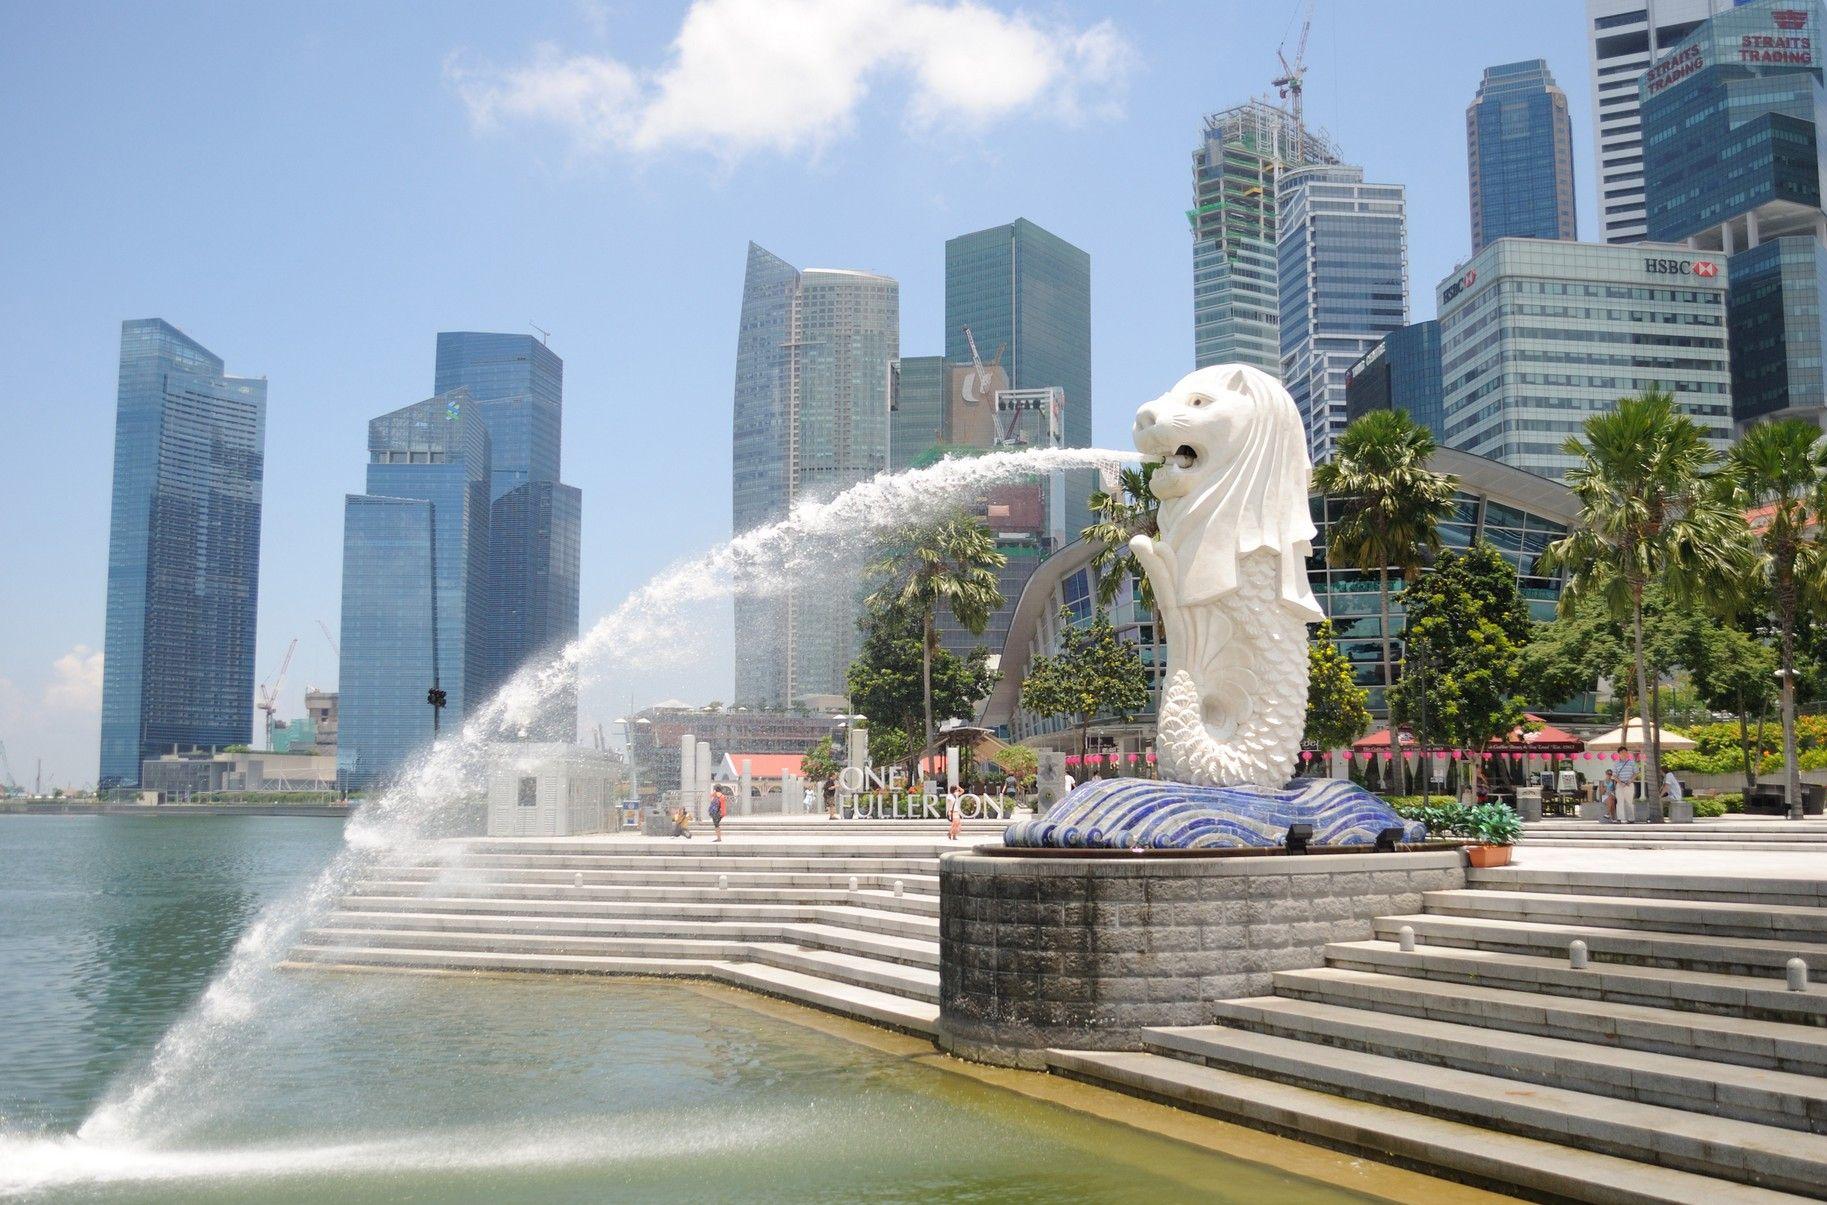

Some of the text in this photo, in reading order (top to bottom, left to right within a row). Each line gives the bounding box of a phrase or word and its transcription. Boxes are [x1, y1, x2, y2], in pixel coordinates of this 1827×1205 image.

[1743, 36, 1810, 48] STRAITS
[1647, 44, 1700, 80] STRAITS
[1739, 50, 1811, 63] TRADING
[1648, 57, 1703, 94] TRADING
[1644, 258, 1691, 275] HSBC
[1443, 277, 1463, 305] HSBC
[839, 766, 903, 791] ONE
